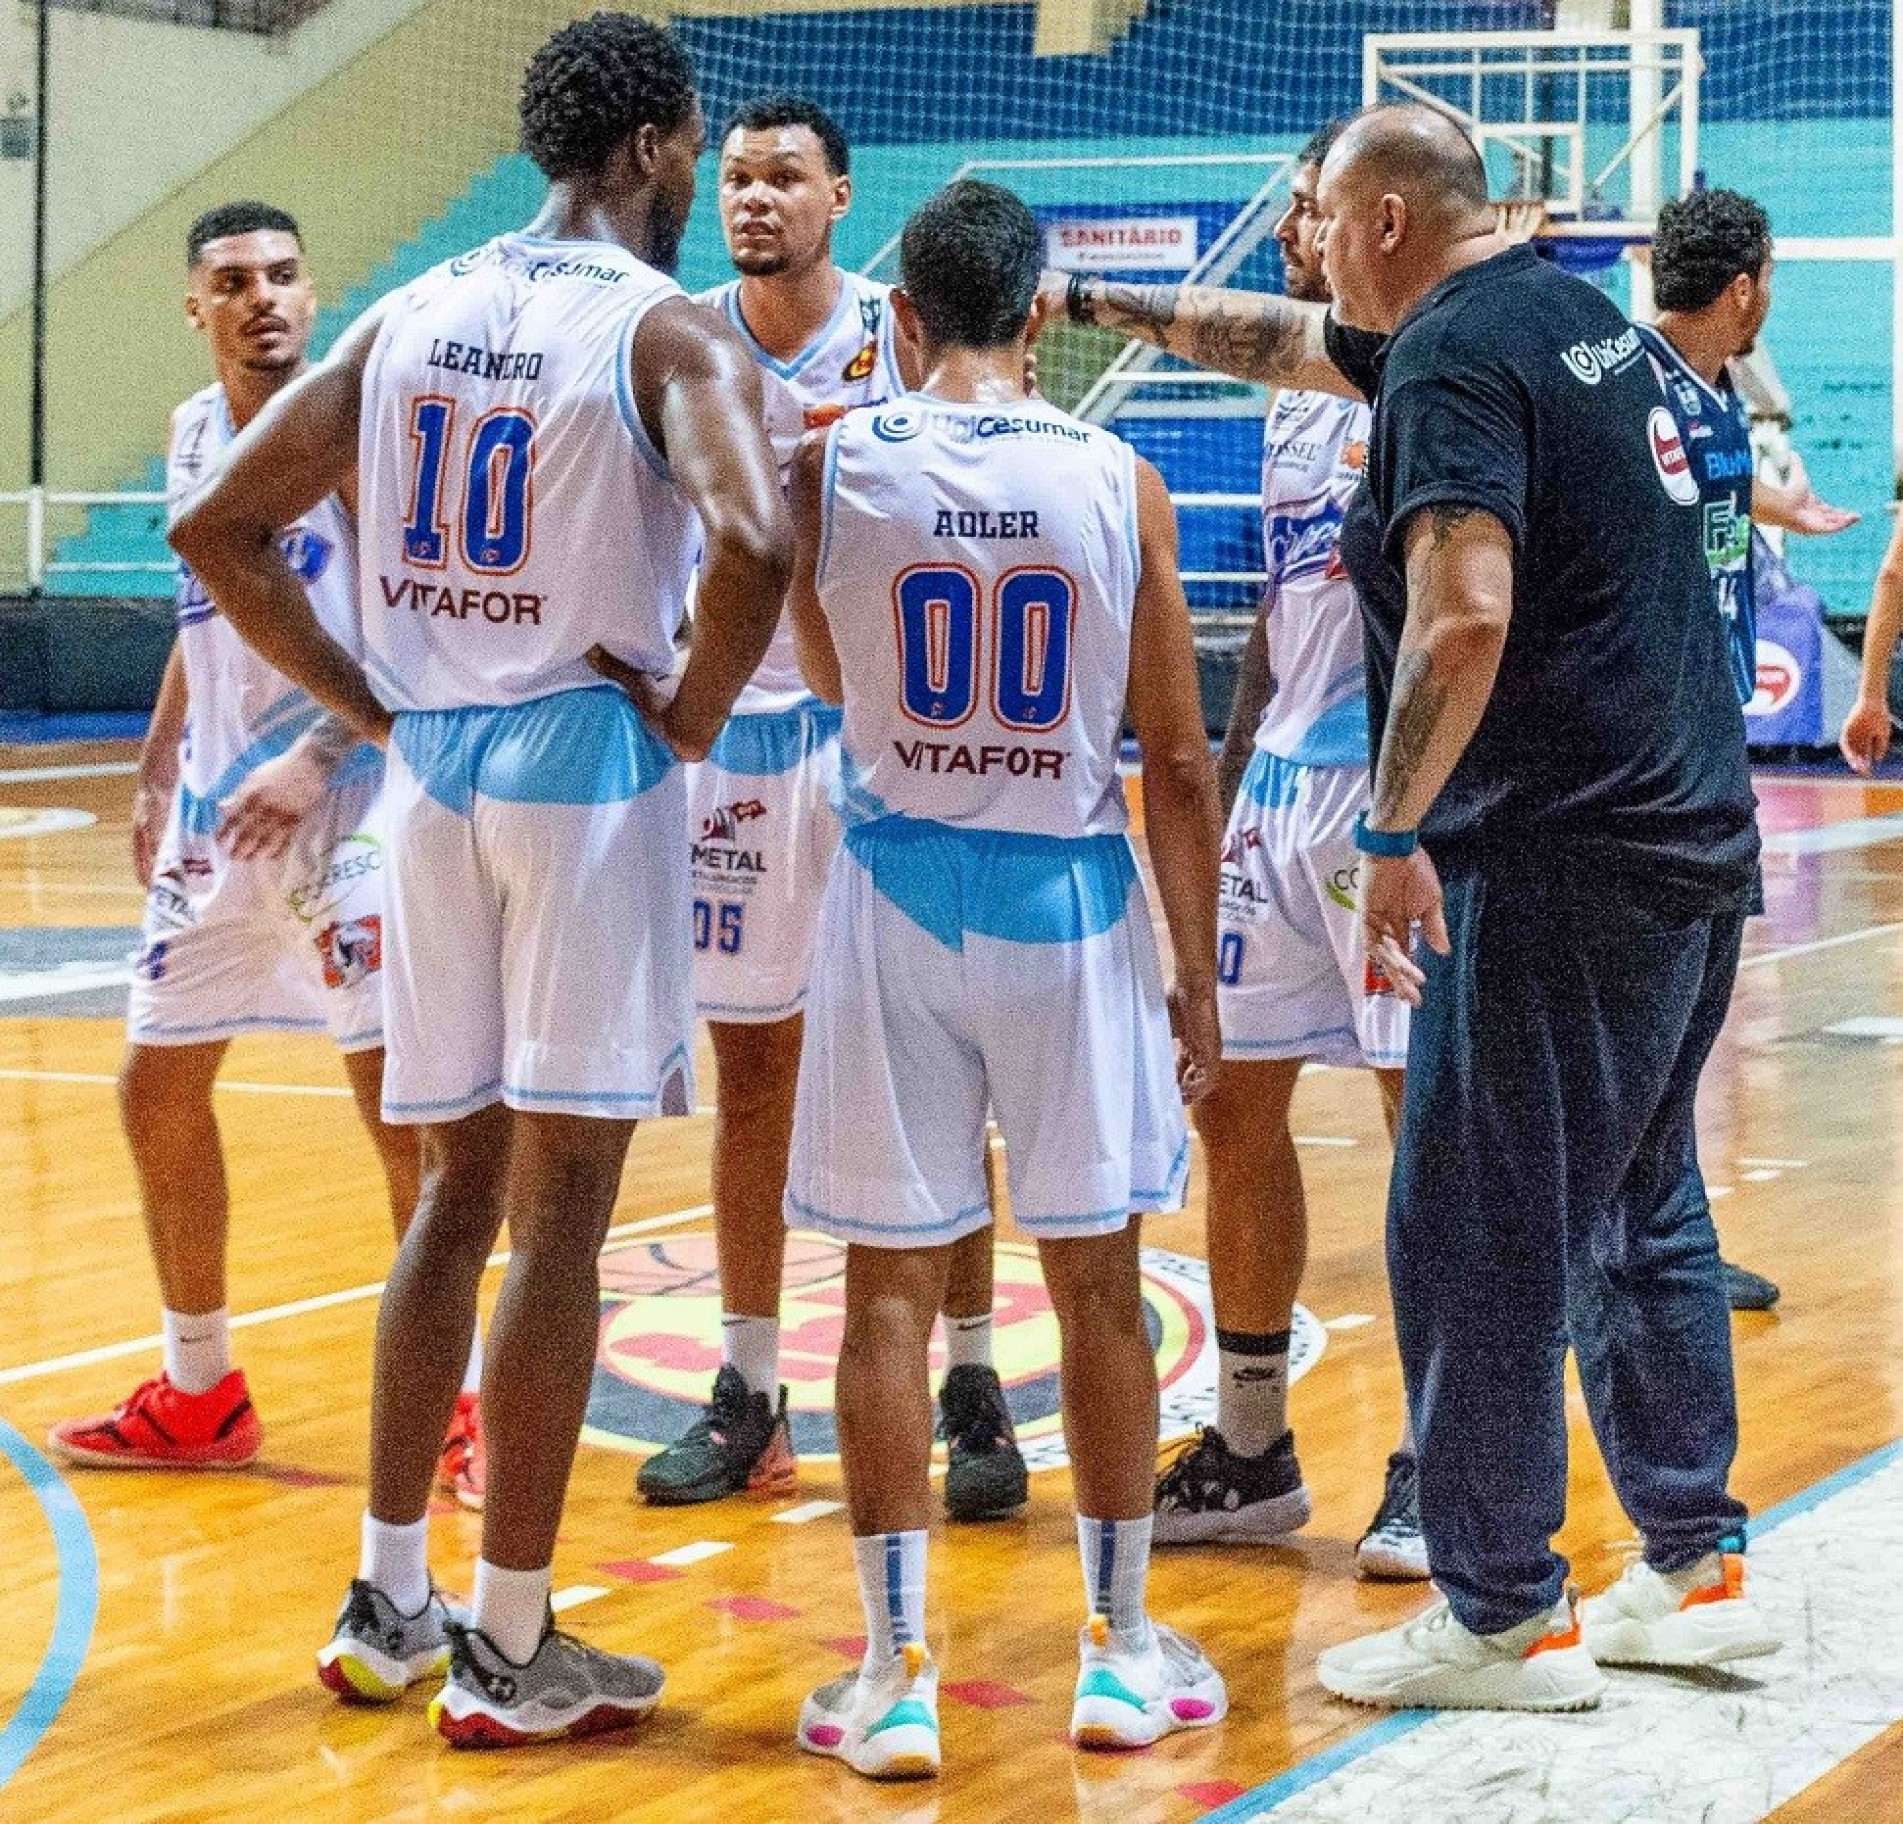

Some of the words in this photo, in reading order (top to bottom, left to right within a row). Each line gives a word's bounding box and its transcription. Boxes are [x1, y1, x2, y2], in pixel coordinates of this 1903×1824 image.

[427, 338, 544, 381] LEANDRO
[401, 394, 538, 577] 10
[932, 510, 1040, 540] ADLER
[379, 574, 542, 626] VITAFOR
[891, 561, 1079, 733] 00
[892, 739, 1064, 780] VITAFOR
[1219, 873, 1269, 904] ETAL
[693, 899, 743, 955] 05
